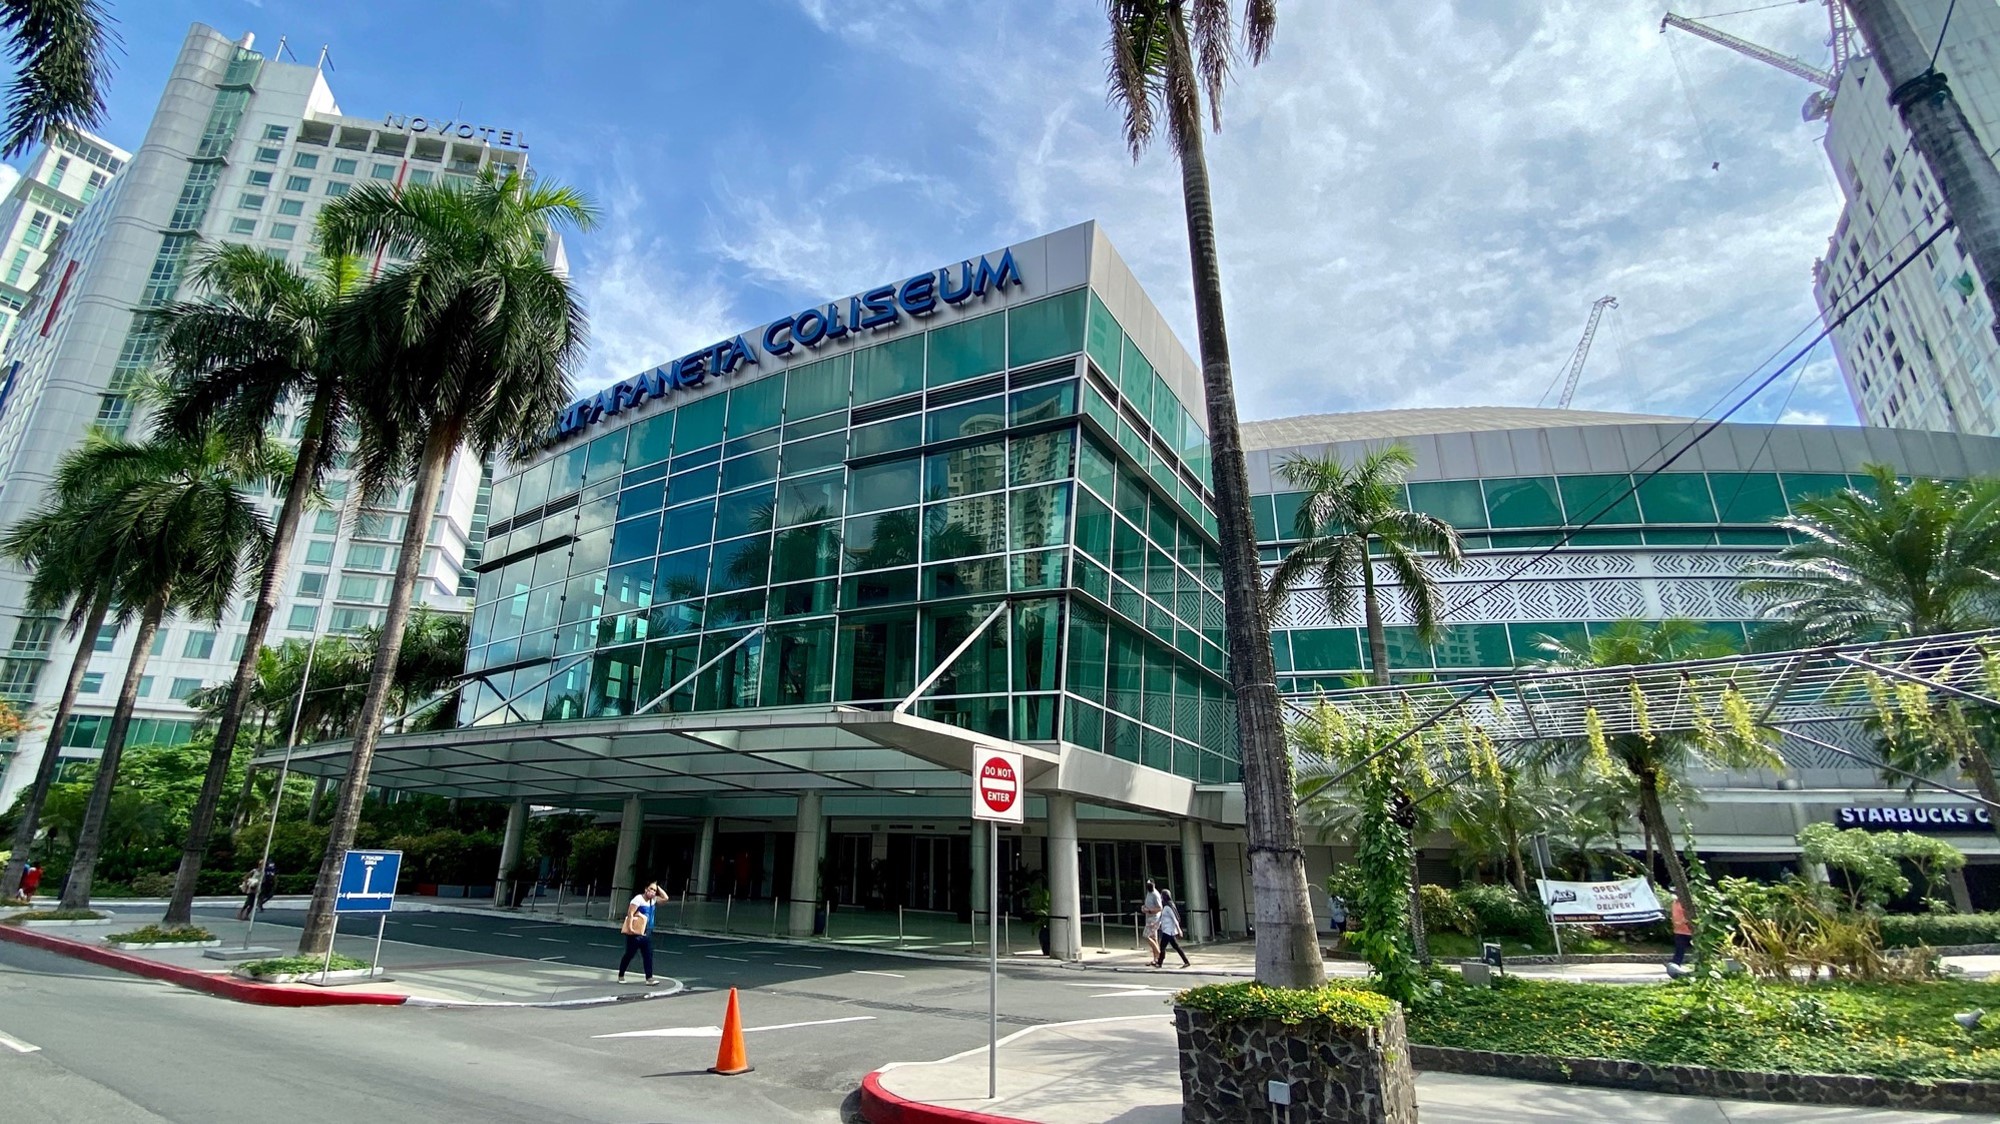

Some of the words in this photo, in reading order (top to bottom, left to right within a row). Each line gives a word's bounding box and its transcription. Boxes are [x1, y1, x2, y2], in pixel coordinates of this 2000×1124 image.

[384, 112, 529, 149] NOVOTEL
[587, 334, 757, 424] ARANETA
[762, 247, 1022, 356] COLISEUM
[985, 765, 995, 775] DO
[998, 767, 1012, 778] NOT
[987, 791, 1010, 803] ENTER
[1840, 807, 1968, 823] STARBUCKS
[1974, 807, 1989, 823] C
[1592, 885, 1621, 893] OPEN
[1594, 892, 1632, 900] TAKE-OUT
[1597, 902, 1635, 910] DELIVERY
